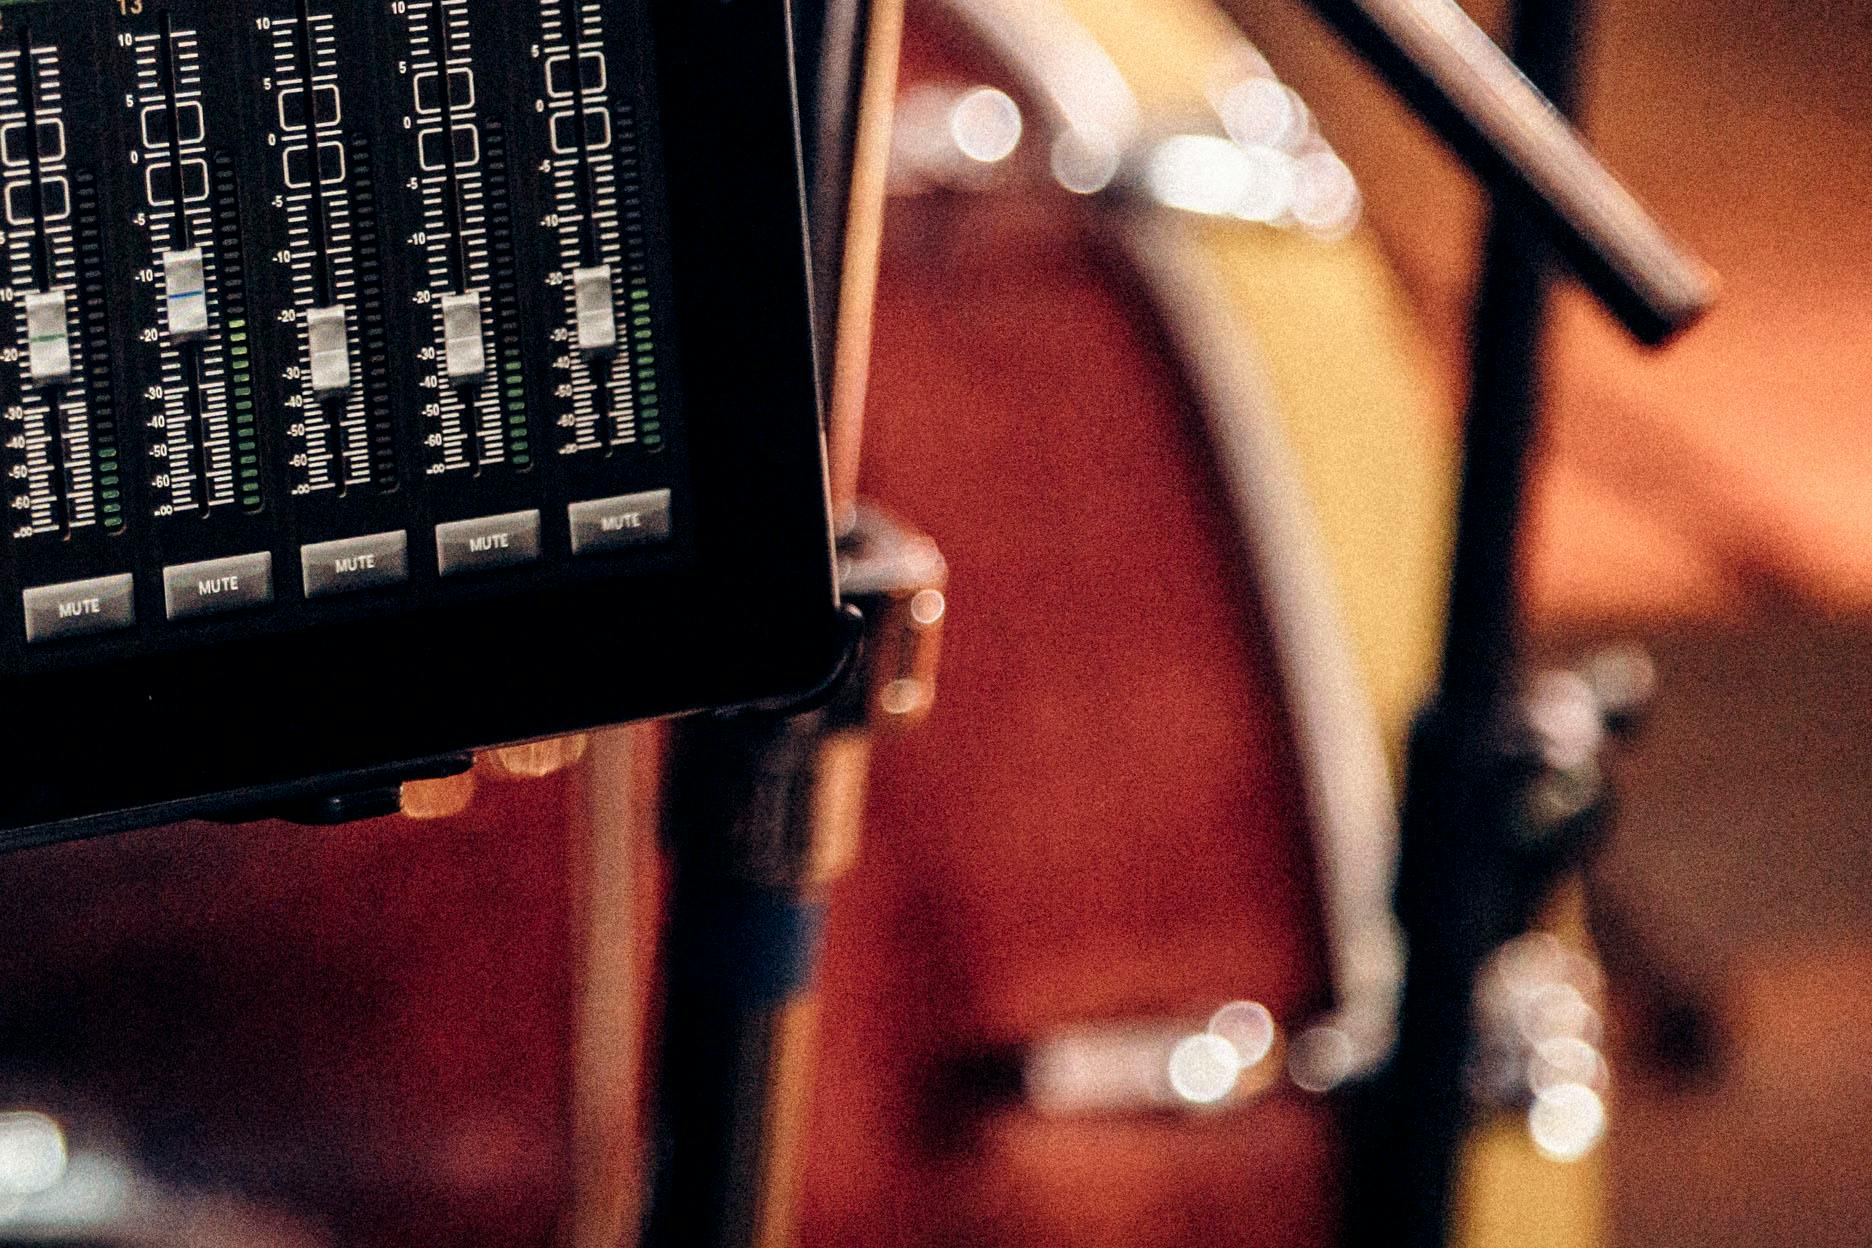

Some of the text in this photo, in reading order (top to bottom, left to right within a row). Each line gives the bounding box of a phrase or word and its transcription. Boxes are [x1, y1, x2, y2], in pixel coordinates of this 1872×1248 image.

[391, 1, 405, 14] 10
[256, 17, 270, 30] 10
[118, 33, 132, 47] 10
[531, 44, 540, 57] 5
[399, 62, 407, 74] 5
[264, 77, 272, 90] 5
[126, 94, 134, 108] 5
[536, 99, 544, 112] 0
[403, 116, 411, 129] 0
[268, 133, 276, 146] 0
[131, 151, 138, 164] 0
[539, 160, 551, 173] -5
[407, 177, 418, 190] -5
[272, 195, 283, 208] -5
[134, 213, 145, 226] -5
[541, 213, 559, 227] -10
[407, 232, 426, 245] -10
[273, 250, 291, 263] -10
[135, 269, 153, 282] -10
[545, 271, 563, 285] -20
[413, 290, 430, 303] -20
[278, 309, 296, 322] -20
[140, 328, 158, 342] -20
[0, 348, 18, 362] -20
[417, 346, 435, 360] -30
[282, 366, 300, 379] -30
[419, 376, 437, 388] -40
[144, 386, 163, 399] -30
[554, 384, 573, 397] -50
[285, 395, 303, 408] -40
[4, 406, 23, 420] -30
[422, 403, 440, 416] -50
[147, 415, 165, 429] -40
[287, 423, 305, 437] -50
[6, 436, 25, 449] -40
[424, 433, 442, 446] -60
[150, 444, 167, 458] -50
[290, 453, 308, 466] -60
[9, 465, 27, 479] -50
[152, 474, 170, 488] -60
[12, 495, 30, 509] -60
[601, 510, 642, 531] MUTE
[469, 532, 509, 553] MUTE
[334, 553, 376, 573] MUTE
[198, 576, 239, 596] MUTE
[59, 598, 100, 618] MUTE
